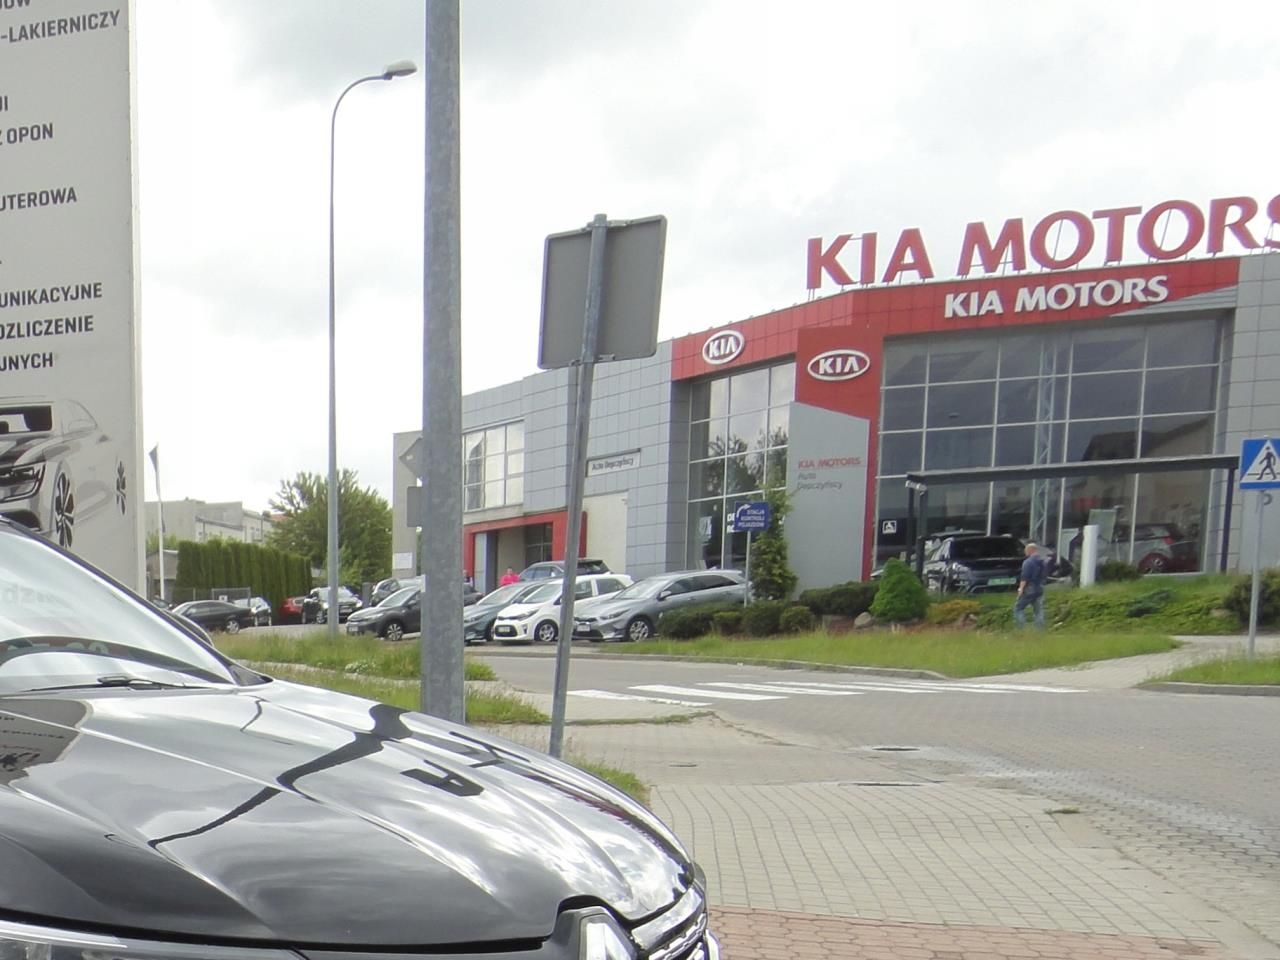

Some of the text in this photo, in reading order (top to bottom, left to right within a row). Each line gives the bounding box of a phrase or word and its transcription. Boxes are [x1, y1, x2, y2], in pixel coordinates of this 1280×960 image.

[6, 123, 53, 145] OPON
[807, 227, 934, 290] KIA
[944, 275, 1169, 318] KIA MOTORS
[819, 356, 860, 375] KIA
[817, 456, 861, 468] MOTORS
